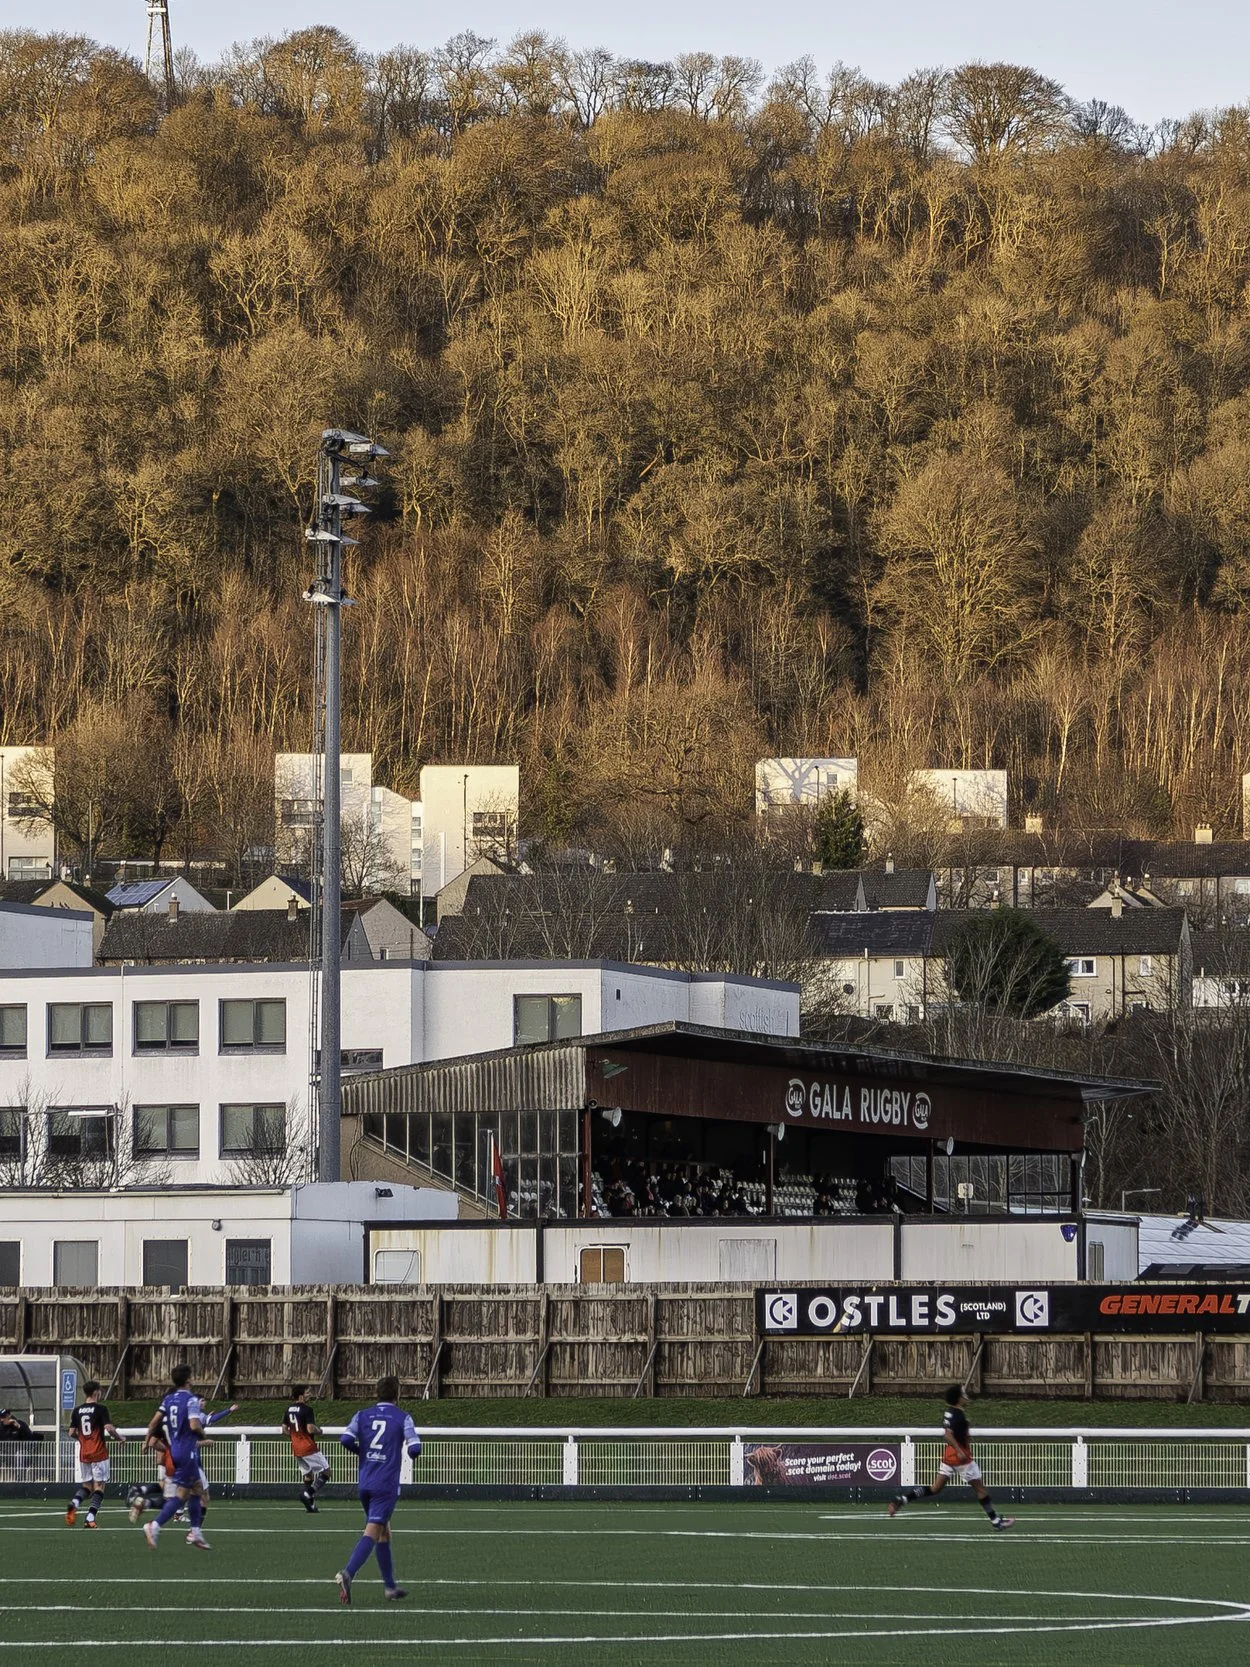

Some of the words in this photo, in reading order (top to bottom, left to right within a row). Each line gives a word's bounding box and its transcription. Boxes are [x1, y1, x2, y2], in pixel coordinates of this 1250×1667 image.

[810, 1082, 852, 1120] GALA
[861, 1088, 911, 1126] RUGBY
[808, 1295, 956, 1327] OSTLES
[960, 1302, 1006, 1312] (SCOTLAND)
[976, 1312, 990, 1320] LTD
[80, 1415, 92, 1436] 6
[169, 1405, 178, 1428] 6
[289, 1413, 299, 1432] 4
[370, 1420, 387, 1449] 2
[785, 1458, 806, 1466] Score
[807, 1456, 825, 1466] your
[826, 1453, 854, 1465] perfect
[805, 1465, 835, 1474] domain
